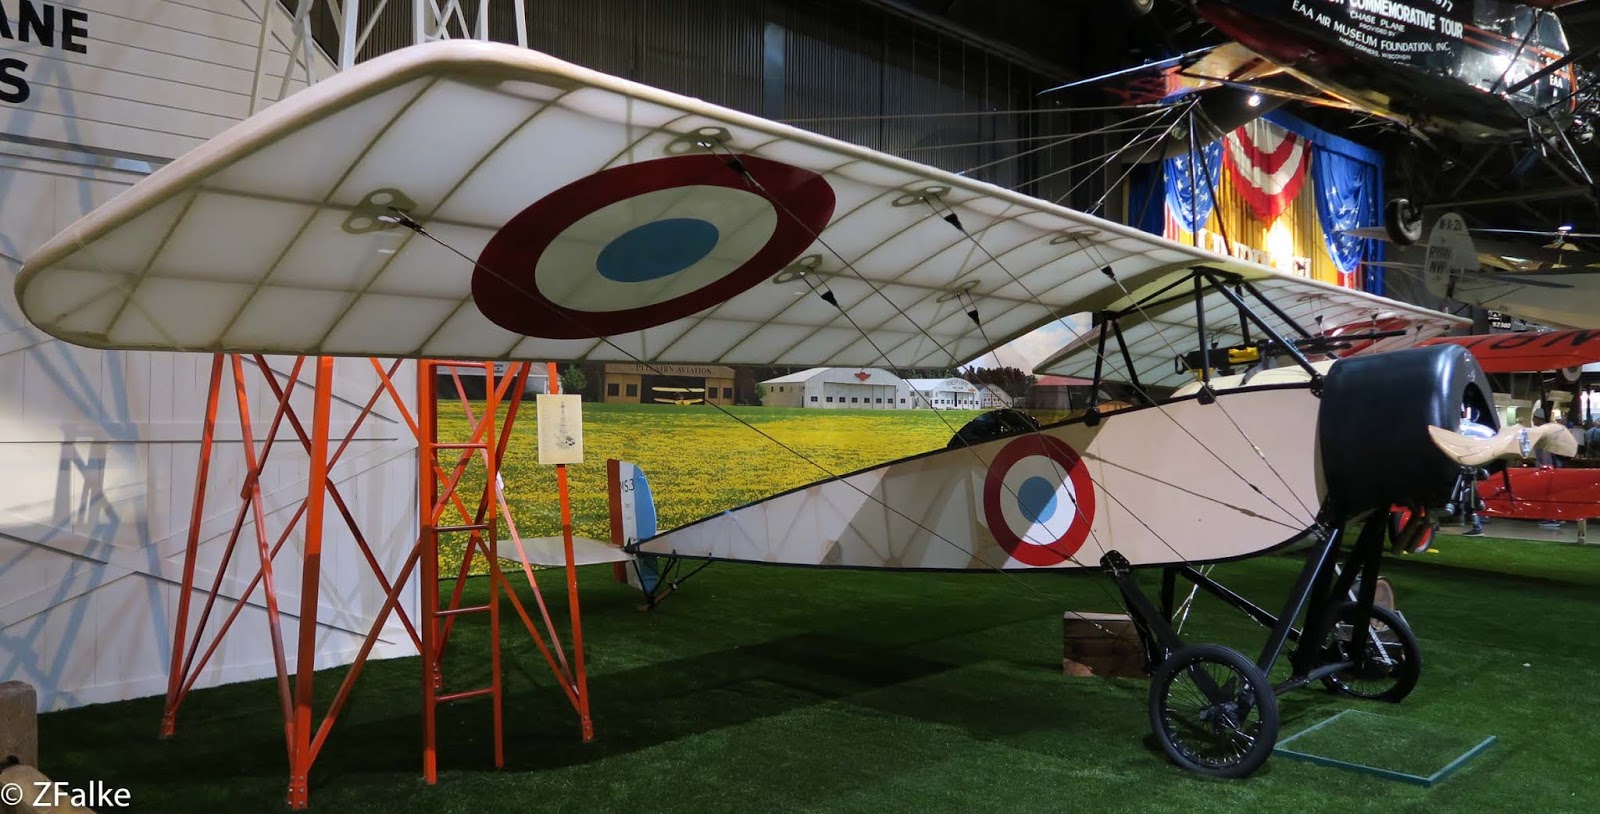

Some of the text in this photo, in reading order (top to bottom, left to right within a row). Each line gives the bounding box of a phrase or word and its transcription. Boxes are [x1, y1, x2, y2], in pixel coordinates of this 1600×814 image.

[1292, 0, 1314, 20] EAA
[1315, 13, 1332, 28] AIR
[1333, 20, 1378, 48] MUSEUM
[1350, 10, 1406, 33] CHASE PLANE
[1439, 16, 1464, 39] TOUR
[679, 365, 712, 375] AVIATION
